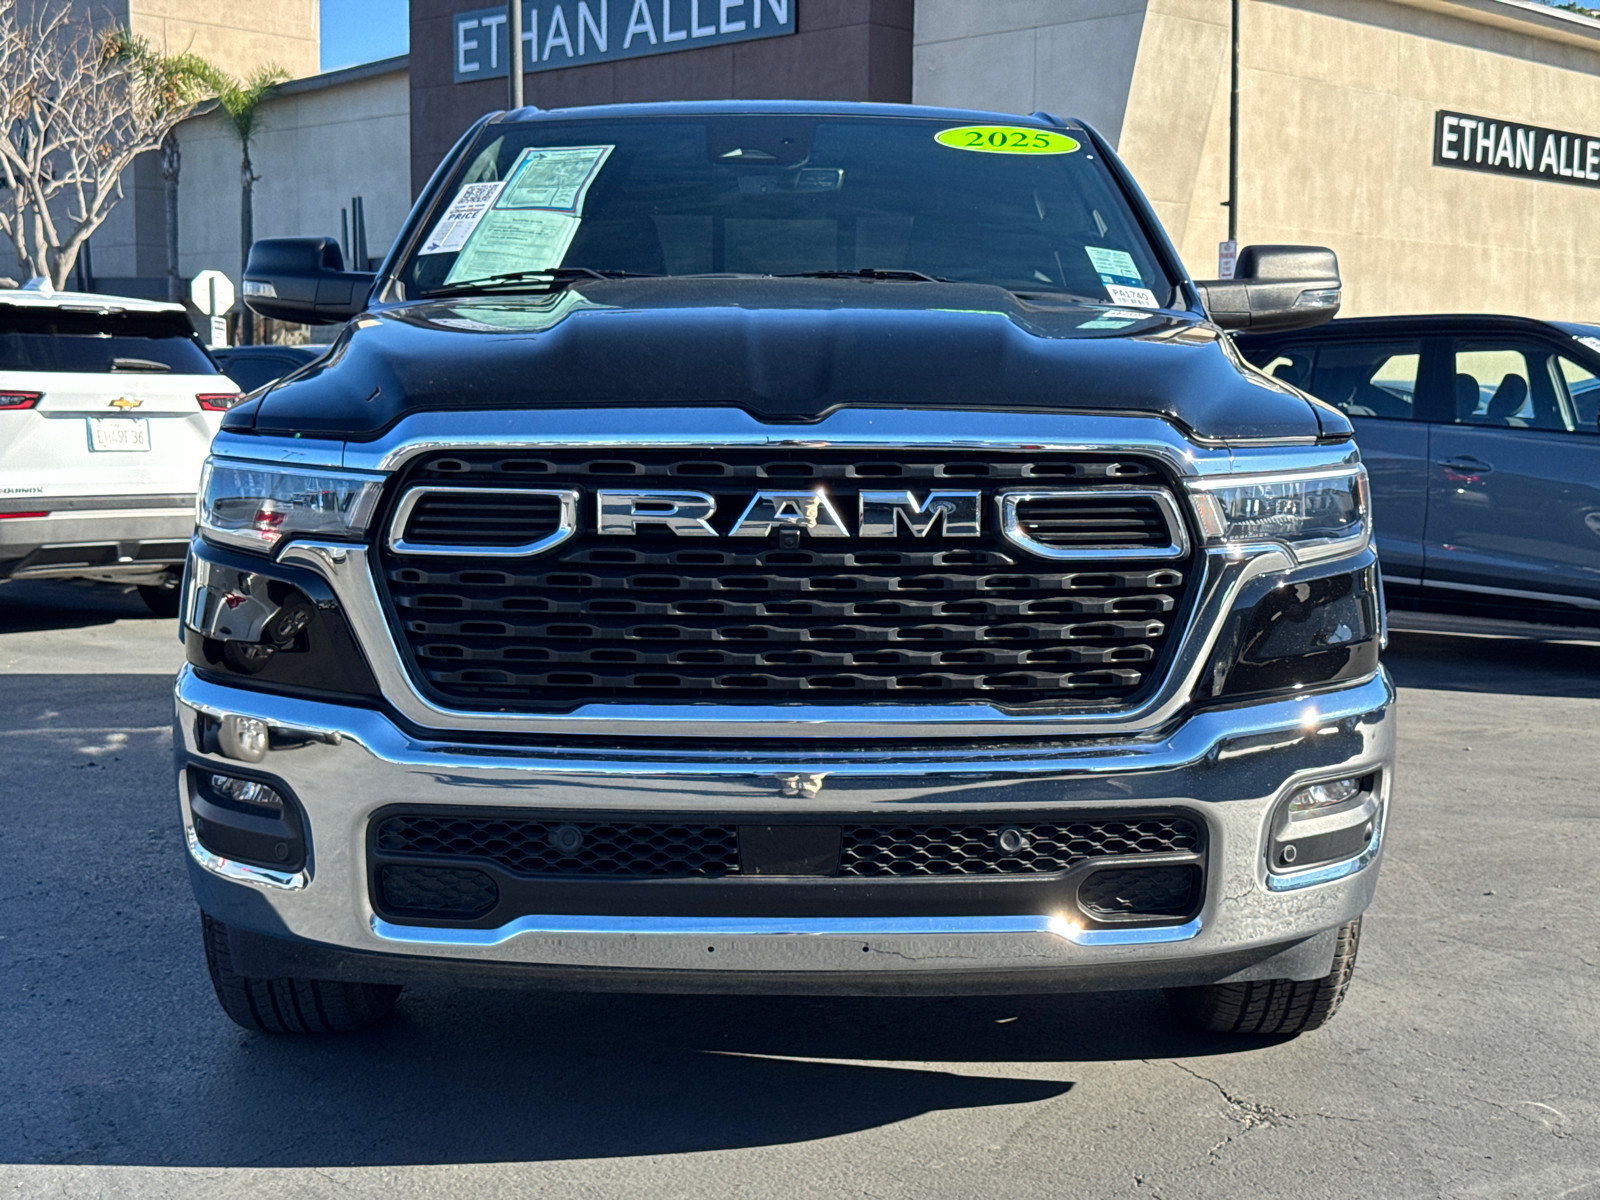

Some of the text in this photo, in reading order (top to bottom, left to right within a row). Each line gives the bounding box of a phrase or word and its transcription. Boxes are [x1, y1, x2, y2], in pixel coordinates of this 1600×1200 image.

[458, 0, 788, 73] ETHAN ALLEN
[965, 131, 1050, 149] 2025
[1441, 115, 1600, 181] ETHAN ALLE
[447, 211, 480, 221] PRICE
[597, 488, 982, 538] RAM
